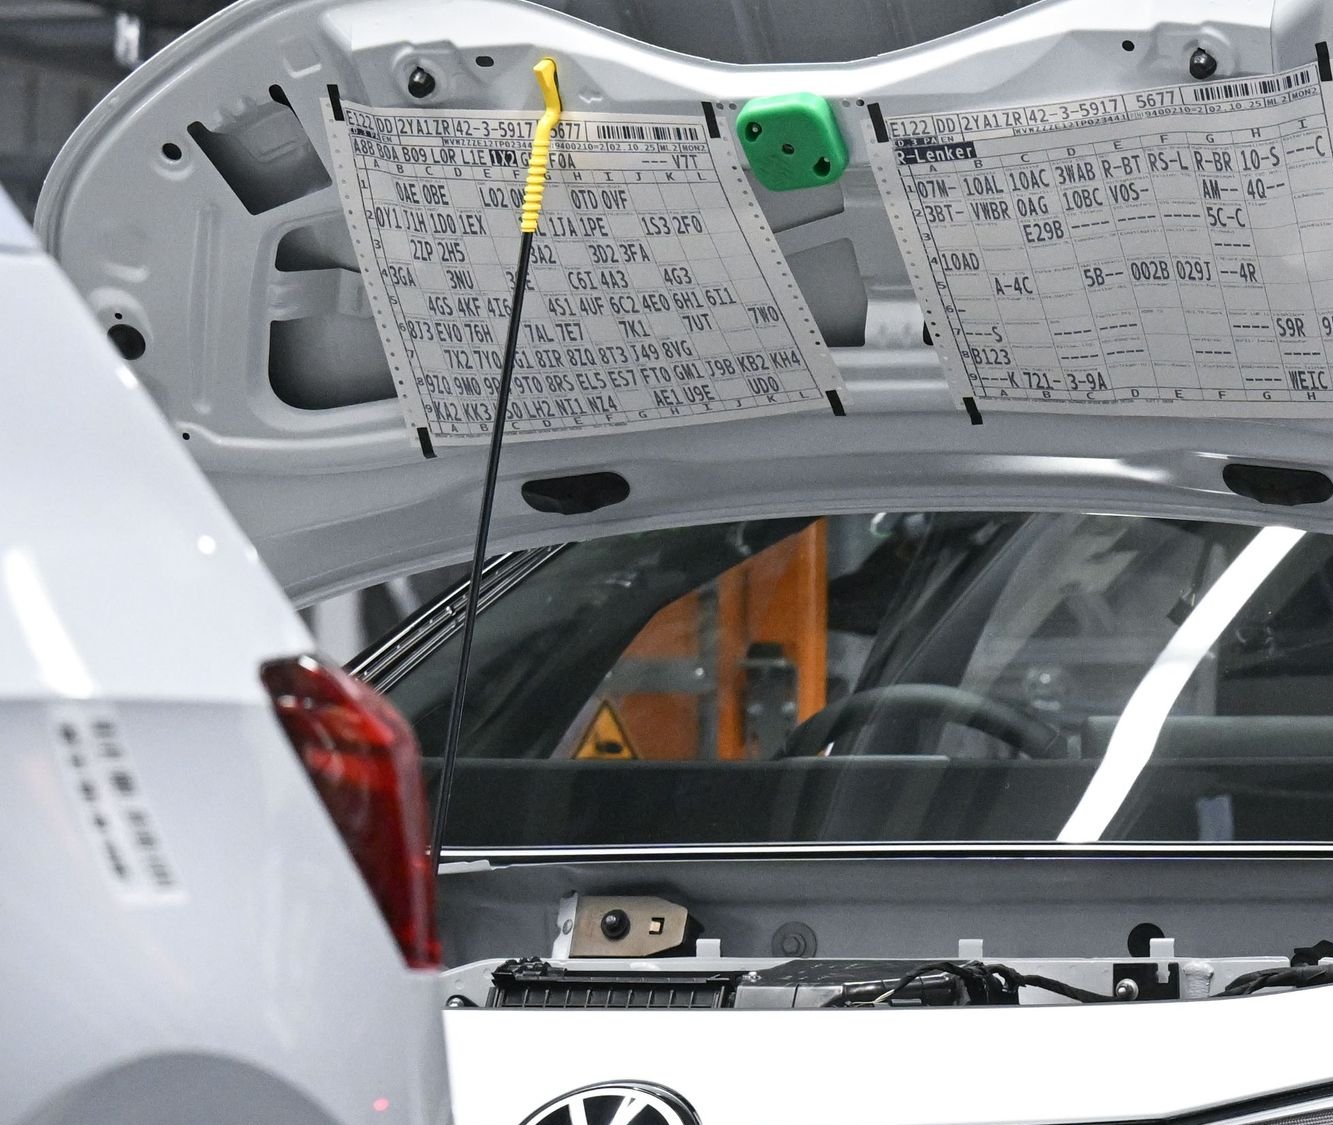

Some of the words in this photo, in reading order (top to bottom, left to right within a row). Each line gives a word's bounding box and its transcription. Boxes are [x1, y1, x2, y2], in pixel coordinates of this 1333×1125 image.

[347, 111, 374, 130] E122
[377, 118, 393, 133] DD
[398, 119, 451, 135] 2YA1ZR
[456, 120, 532, 138] 42-3-5917
[890, 120, 930, 138] E122
[936, 118, 956, 132] DD
[961, 111, 1022, 131] 2YA1ZR
[1029, 99, 1118, 124] 42-3-5917
[1136, 91, 1175, 109] 5677
[402, 147, 428, 162] B09
[461, 150, 487, 165] L1E
[896, 146, 973, 165] R-Lenker
